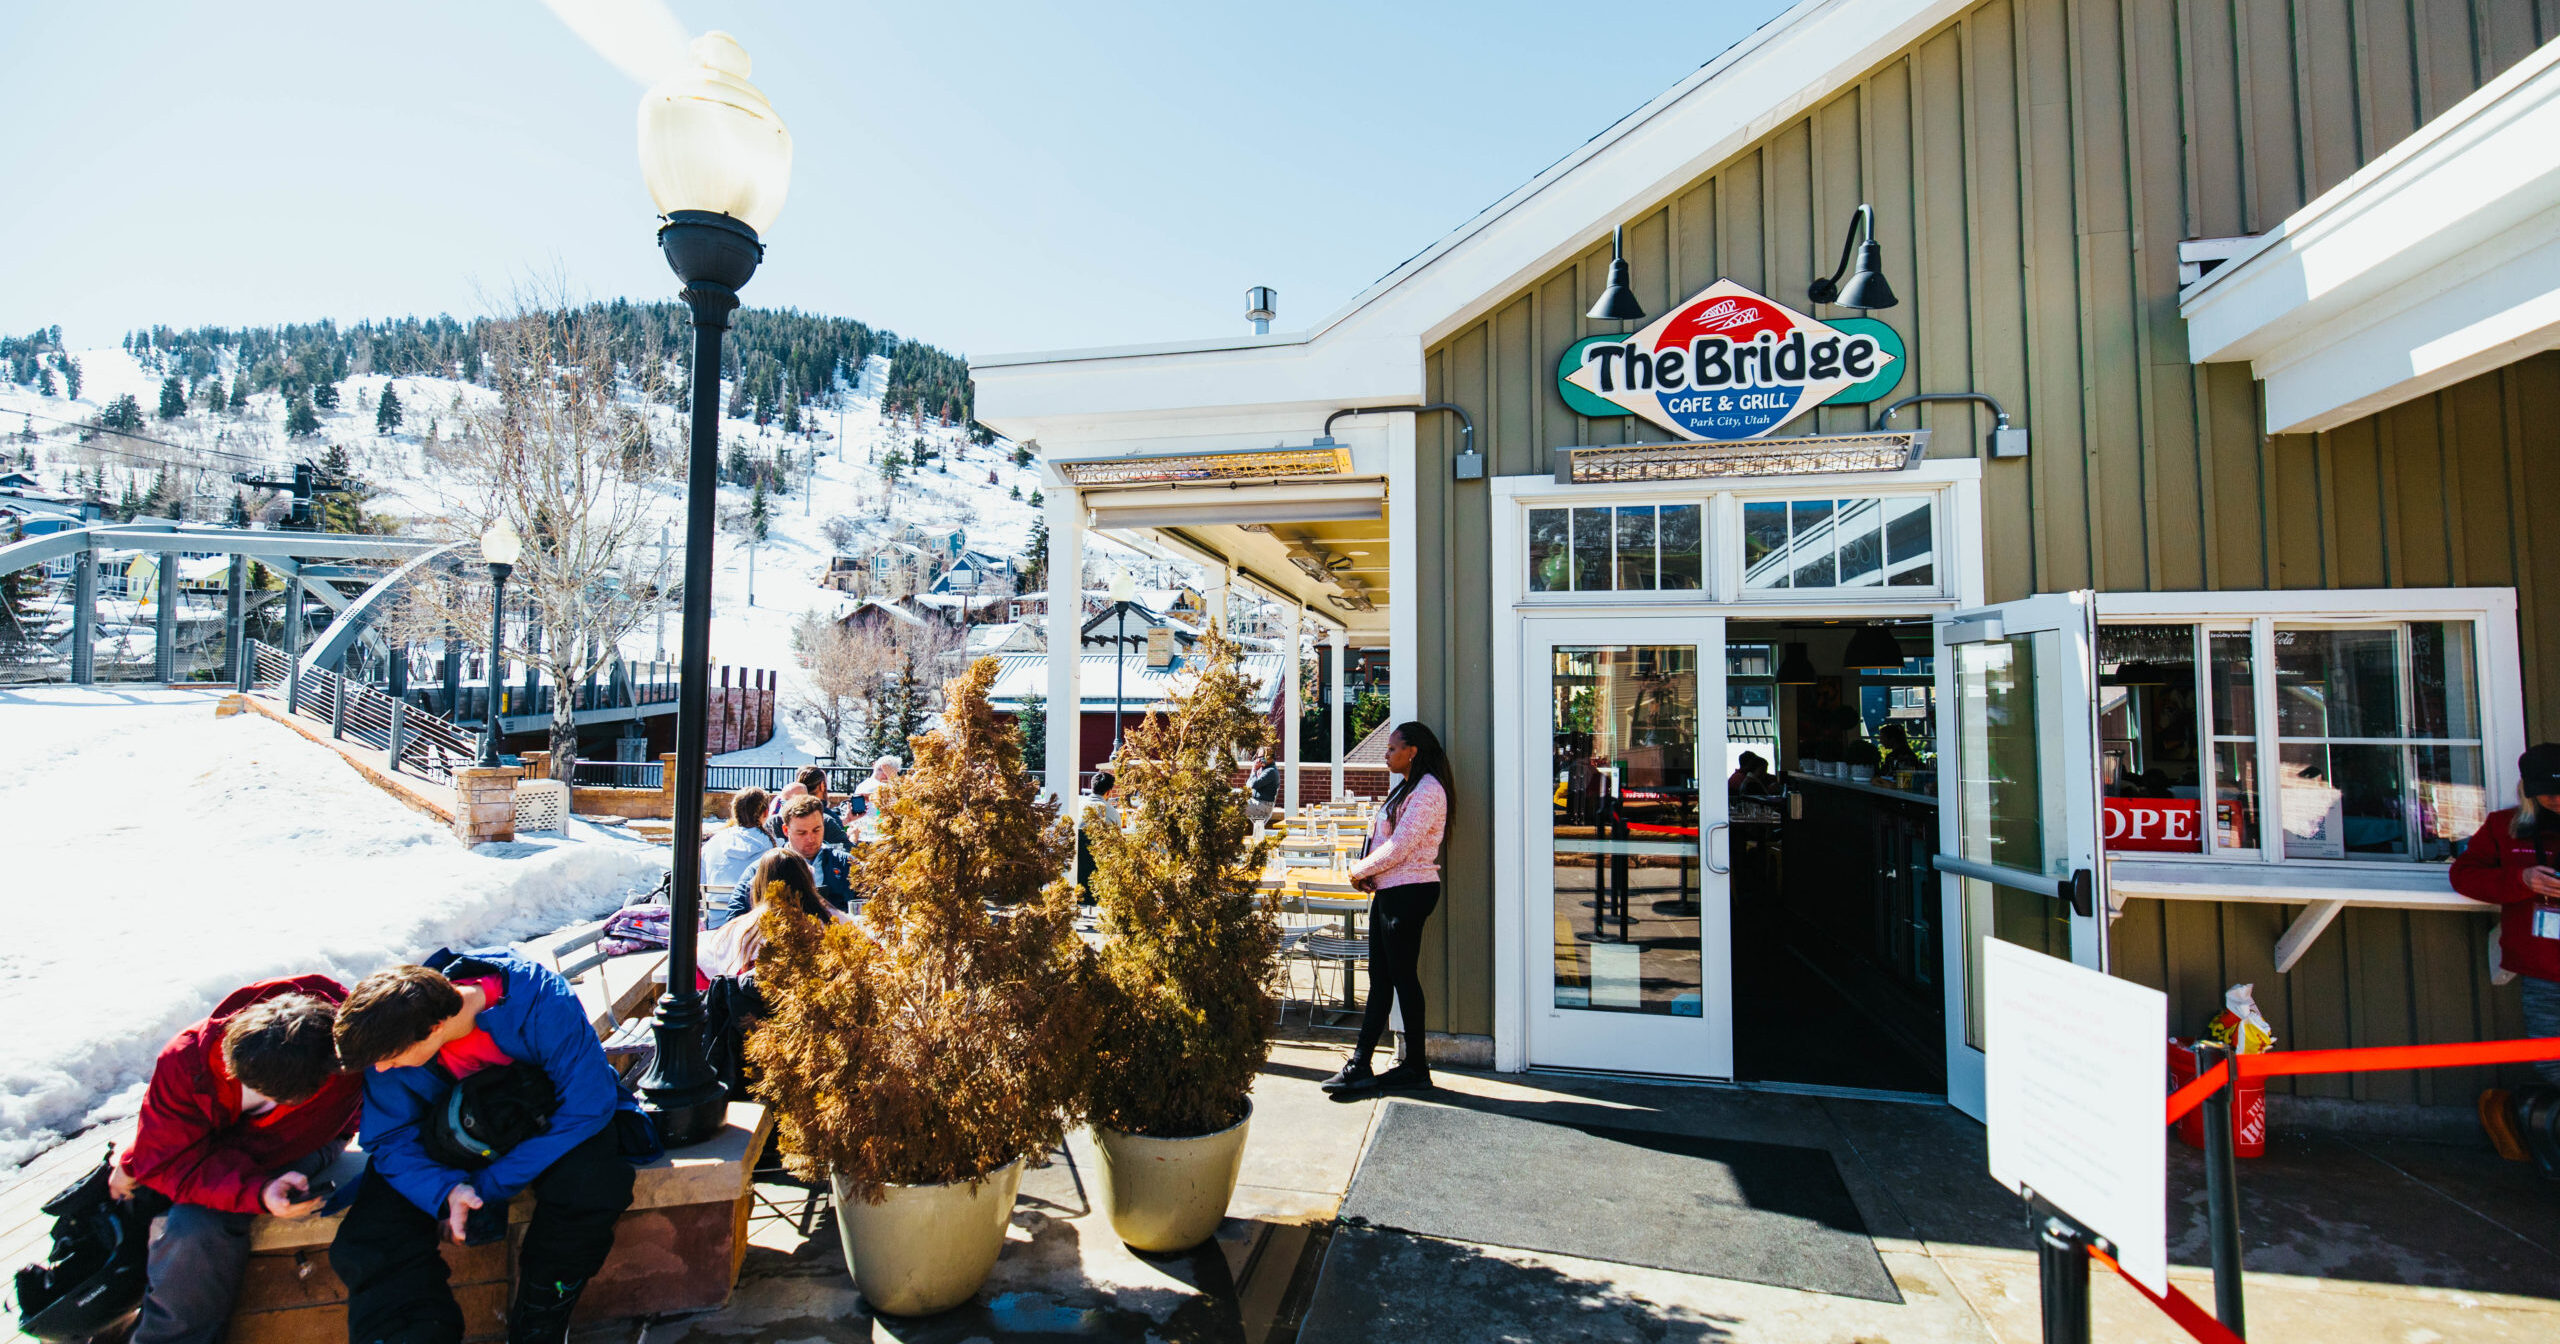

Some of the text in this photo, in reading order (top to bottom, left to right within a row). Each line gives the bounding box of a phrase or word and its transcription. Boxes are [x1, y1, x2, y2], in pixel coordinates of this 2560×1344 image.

[1589, 331, 1875, 392] The Bridge
[1668, 392, 1790, 414] CAFE & GRILL
[1690, 414, 1770, 428] Park City, Utah
[2105, 807, 2202, 841] OPE
